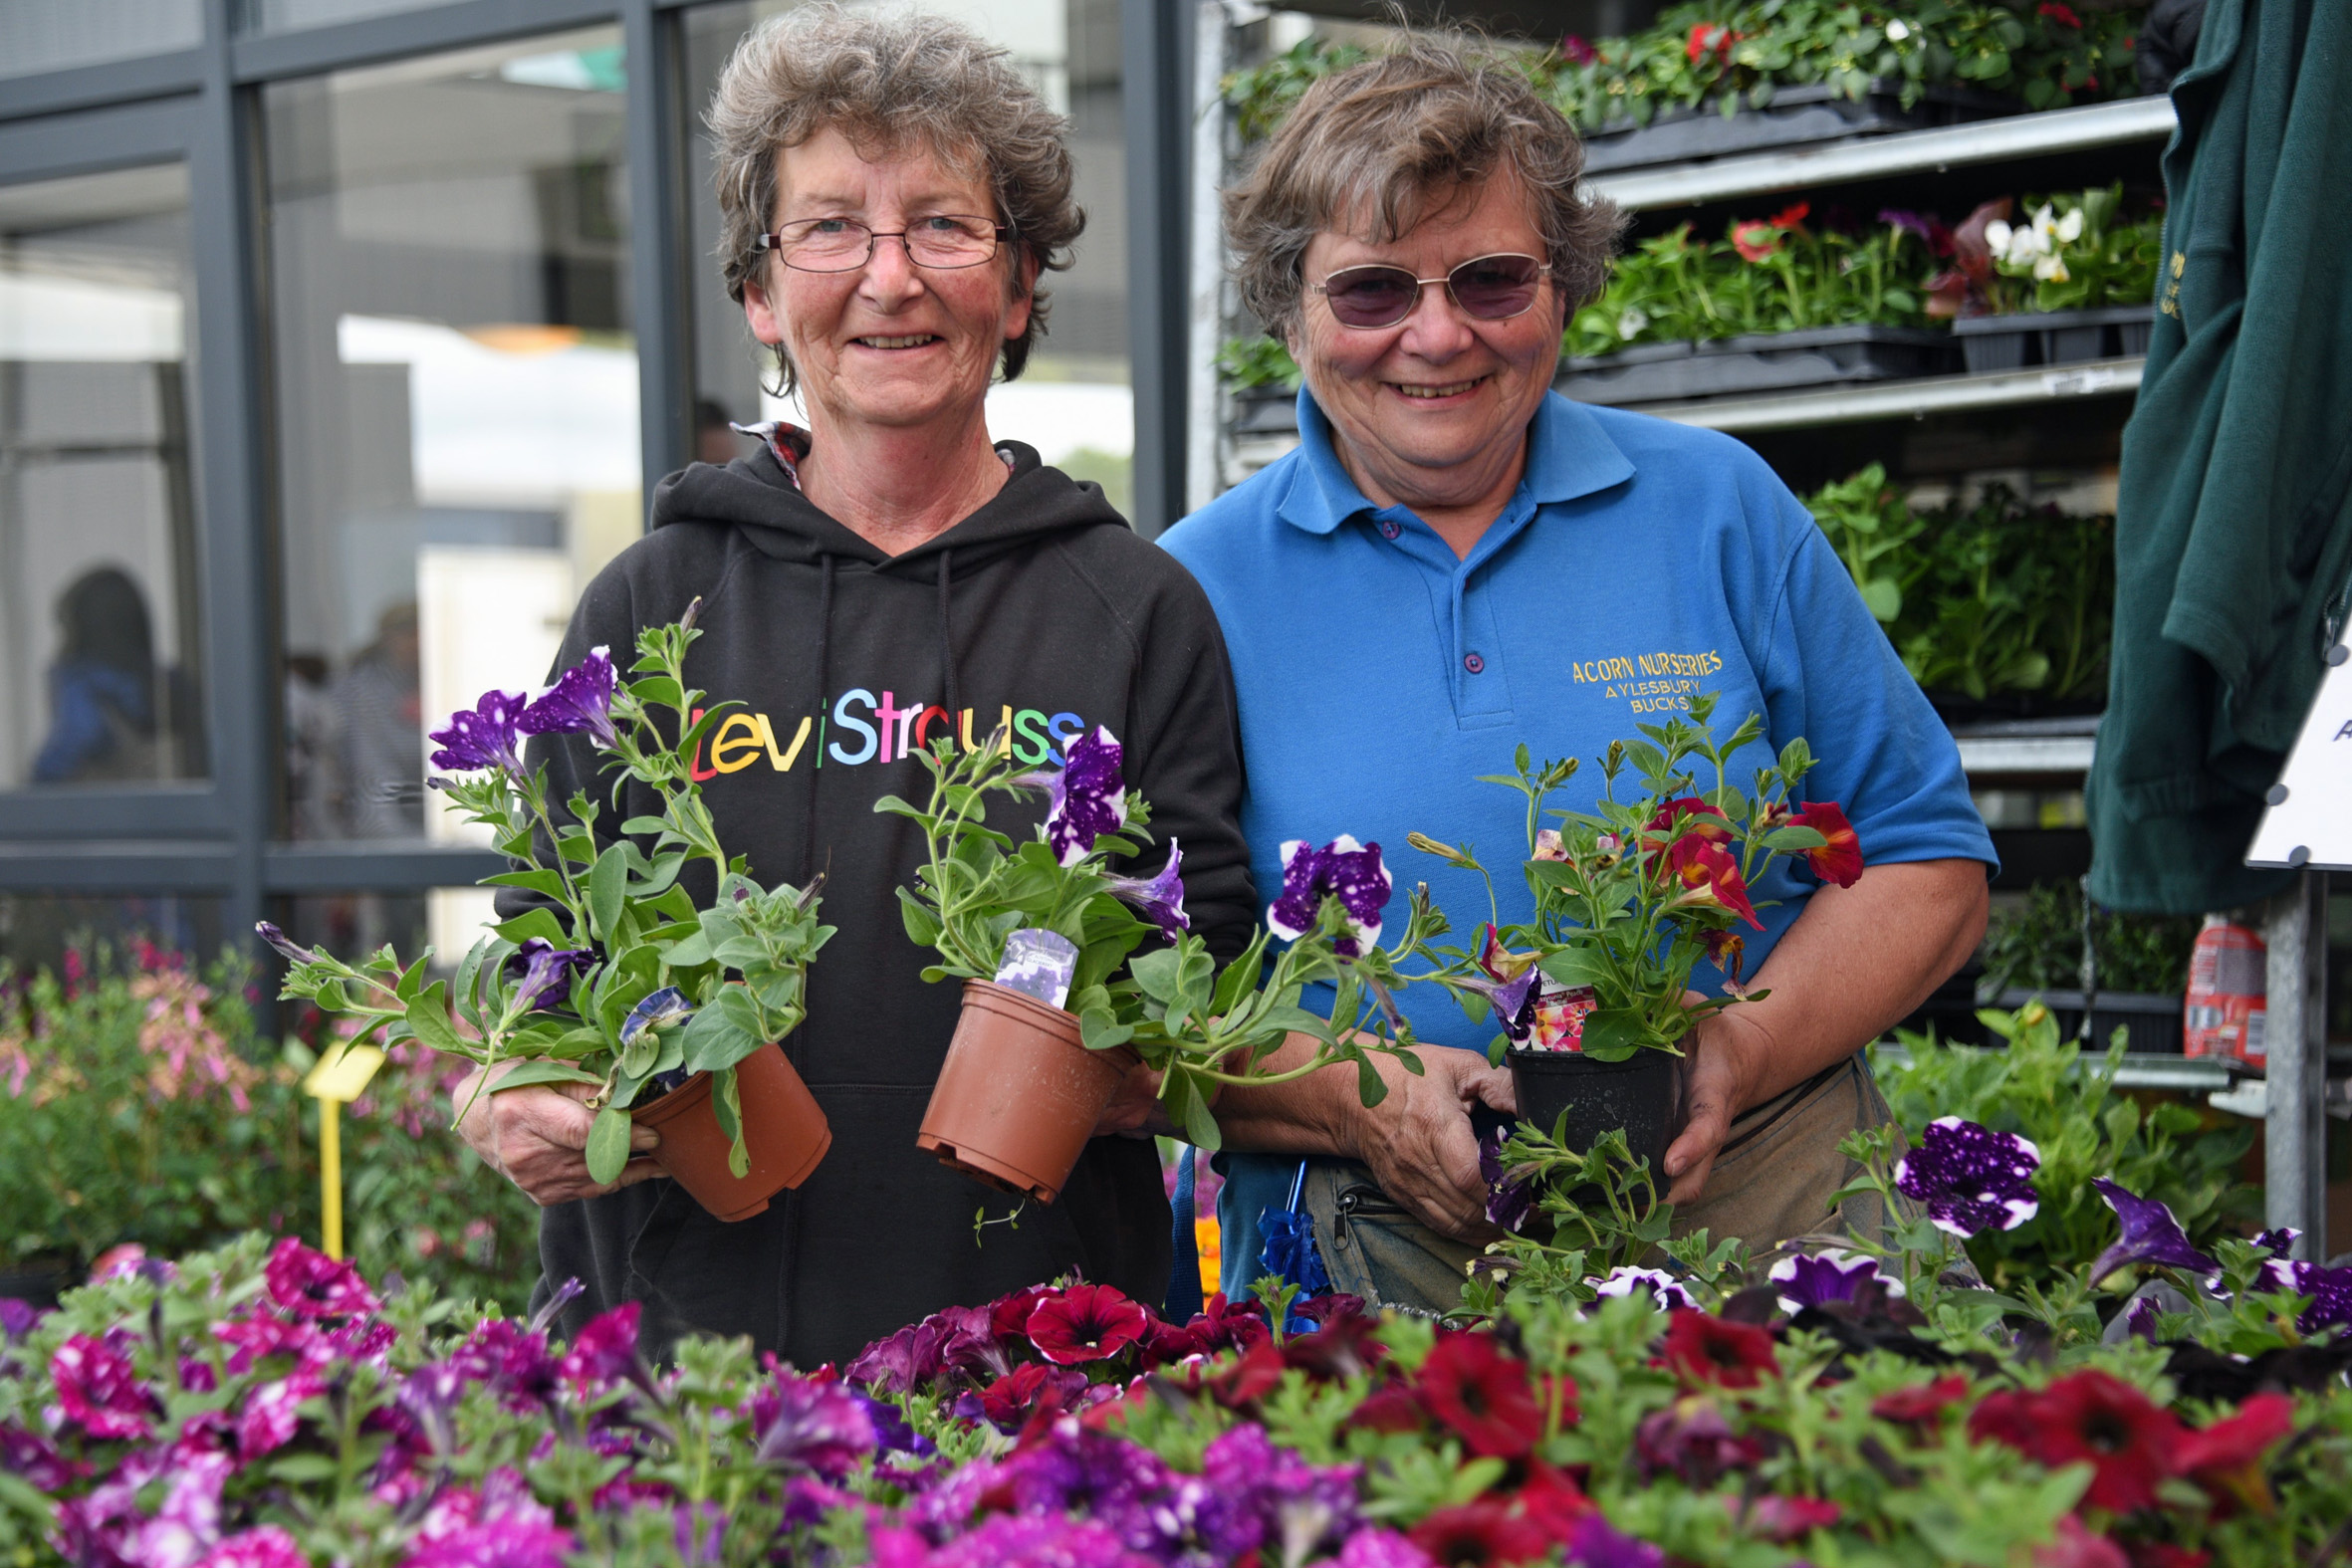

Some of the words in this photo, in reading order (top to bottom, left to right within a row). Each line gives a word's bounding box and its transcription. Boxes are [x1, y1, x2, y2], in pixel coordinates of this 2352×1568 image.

[1572, 656, 1635, 684] ACORN
[1638, 649, 1723, 677] NURSERIES
[1605, 680, 1701, 699] AYLESBURY
[1630, 696, 1690, 714] BUCKS
